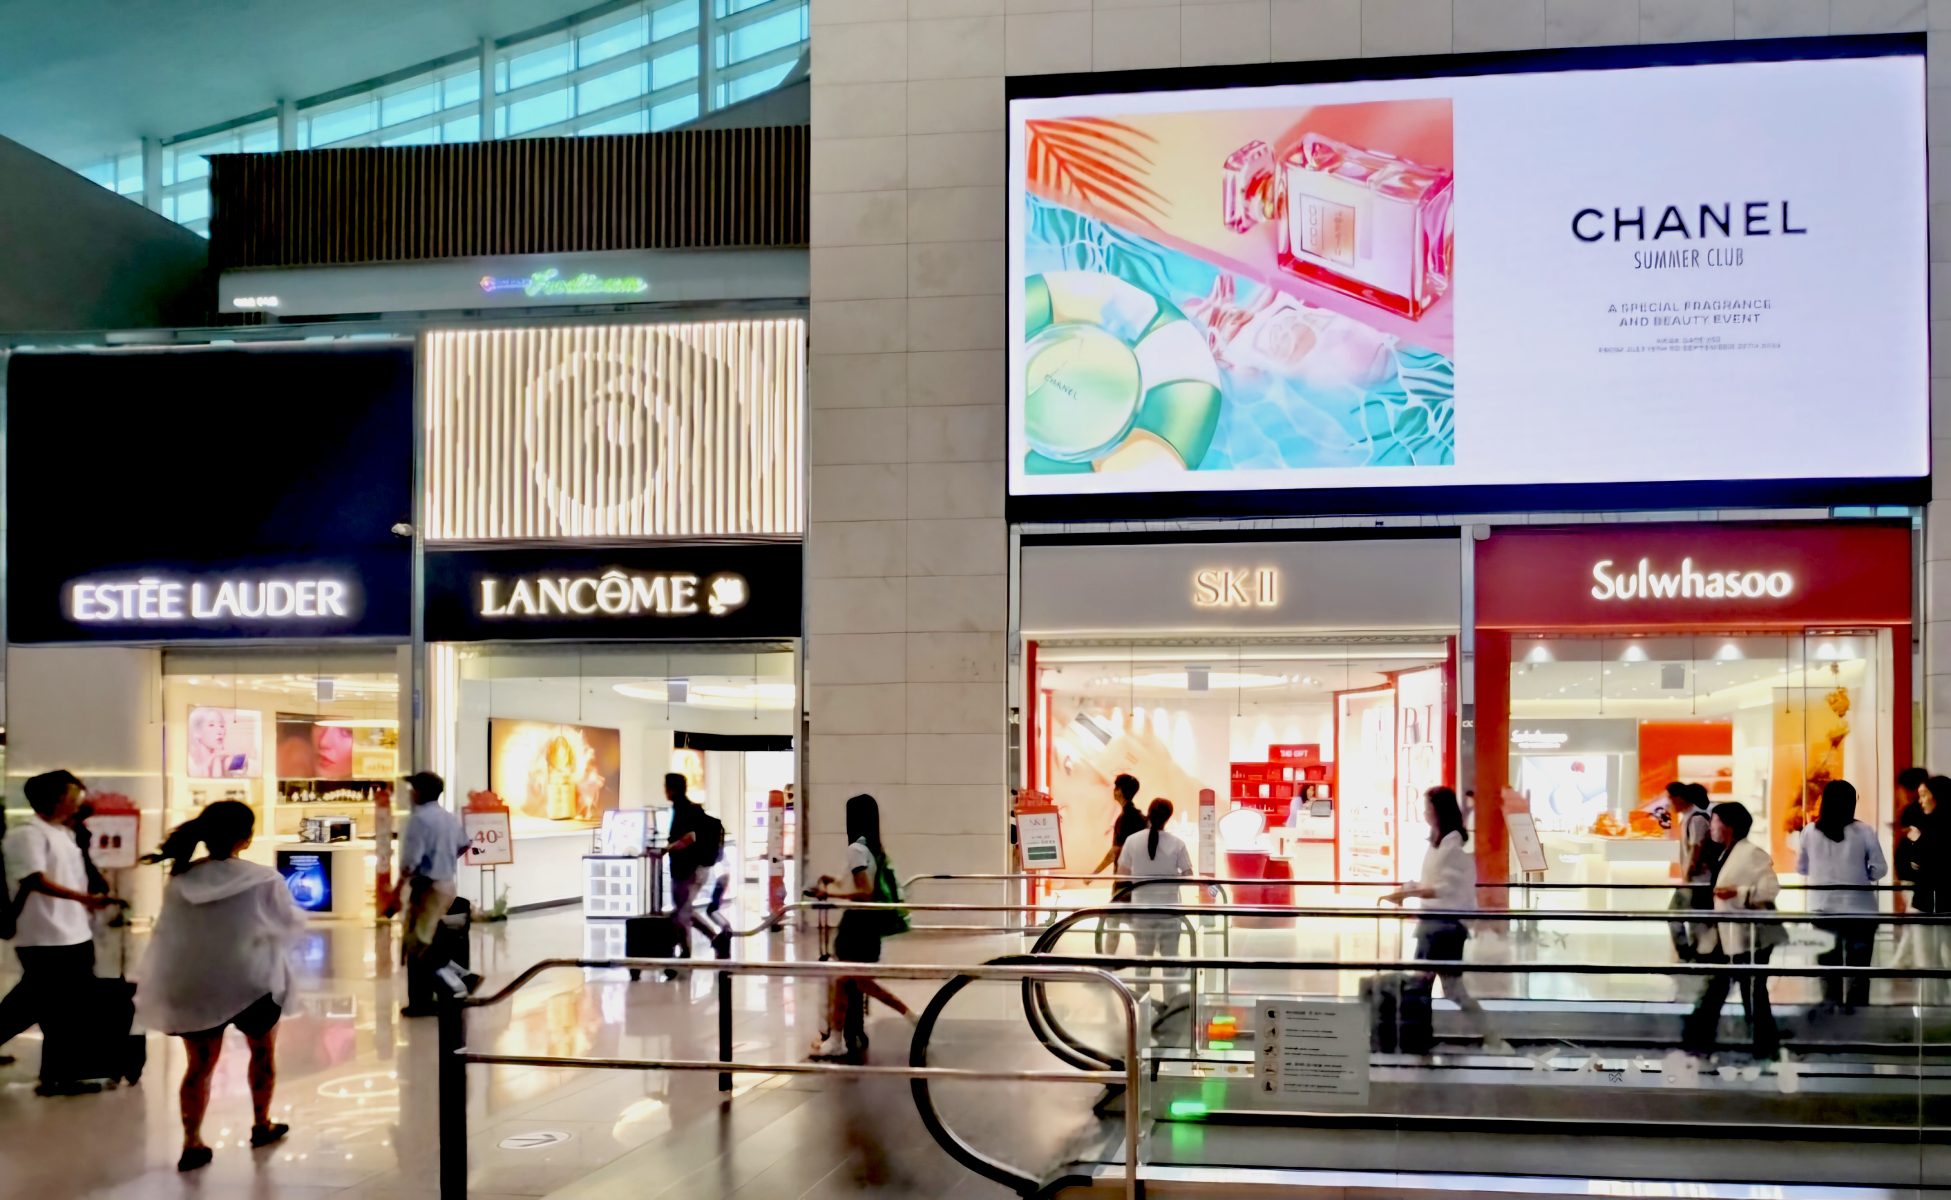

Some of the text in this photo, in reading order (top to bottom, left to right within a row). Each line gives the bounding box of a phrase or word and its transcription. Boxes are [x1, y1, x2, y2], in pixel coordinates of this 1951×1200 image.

[1572, 201, 1807, 243] CHANEL
[1634, 247, 1744, 269] SUMMER CLUB
[1607, 299, 1771, 314] A SPECIAL FRAGRANCE
[1618, 313, 1761, 328] AND BEAUTY EVENT
[480, 570, 698, 615] LANCÔME
[1591, 556, 1794, 601] Sulwhasoo
[191, 581, 347, 619] LAUDER
